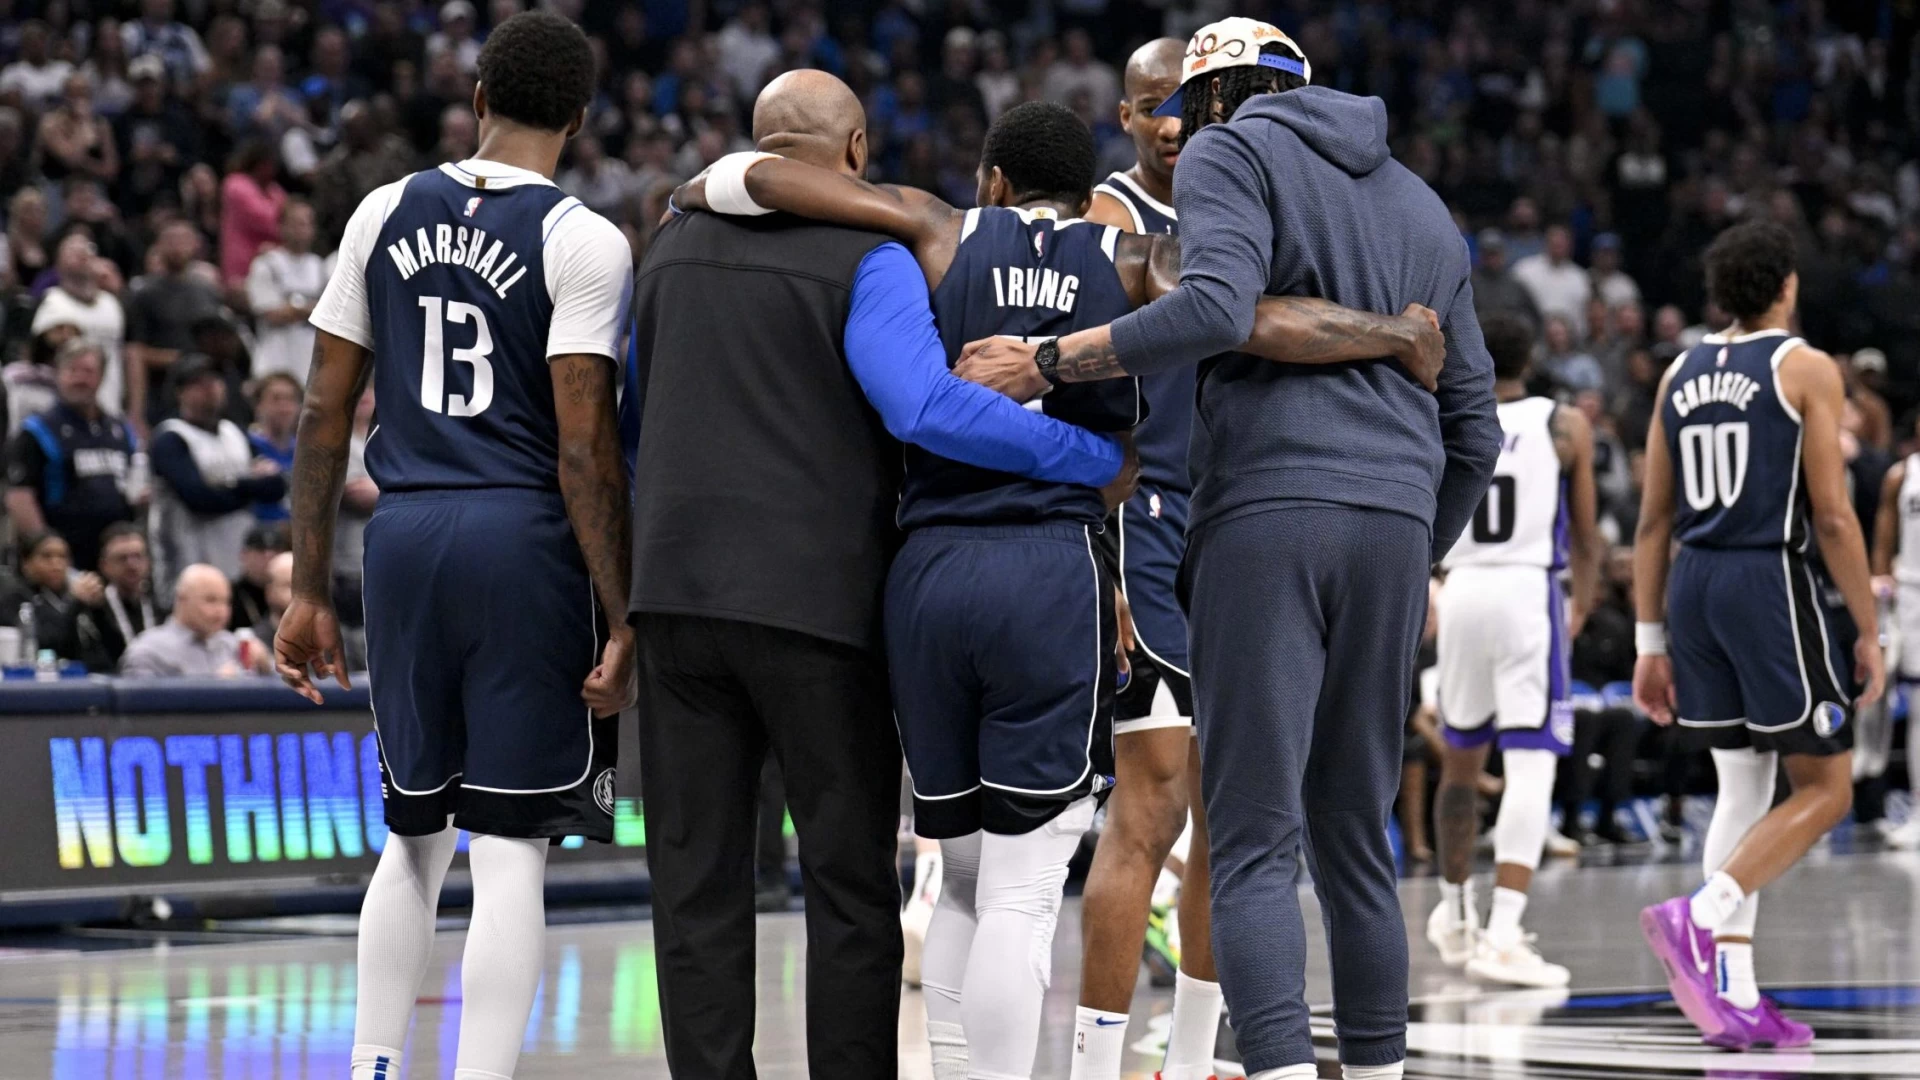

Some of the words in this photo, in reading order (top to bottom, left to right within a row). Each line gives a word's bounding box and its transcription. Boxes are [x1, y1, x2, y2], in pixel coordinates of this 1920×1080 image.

[388, 223, 527, 299] MARSHALL
[992, 265, 1079, 313] IRVNG
[418, 295, 494, 417] 13
[1672, 371, 1761, 418] CHRISTIE
[1679, 421, 1748, 511] 00
